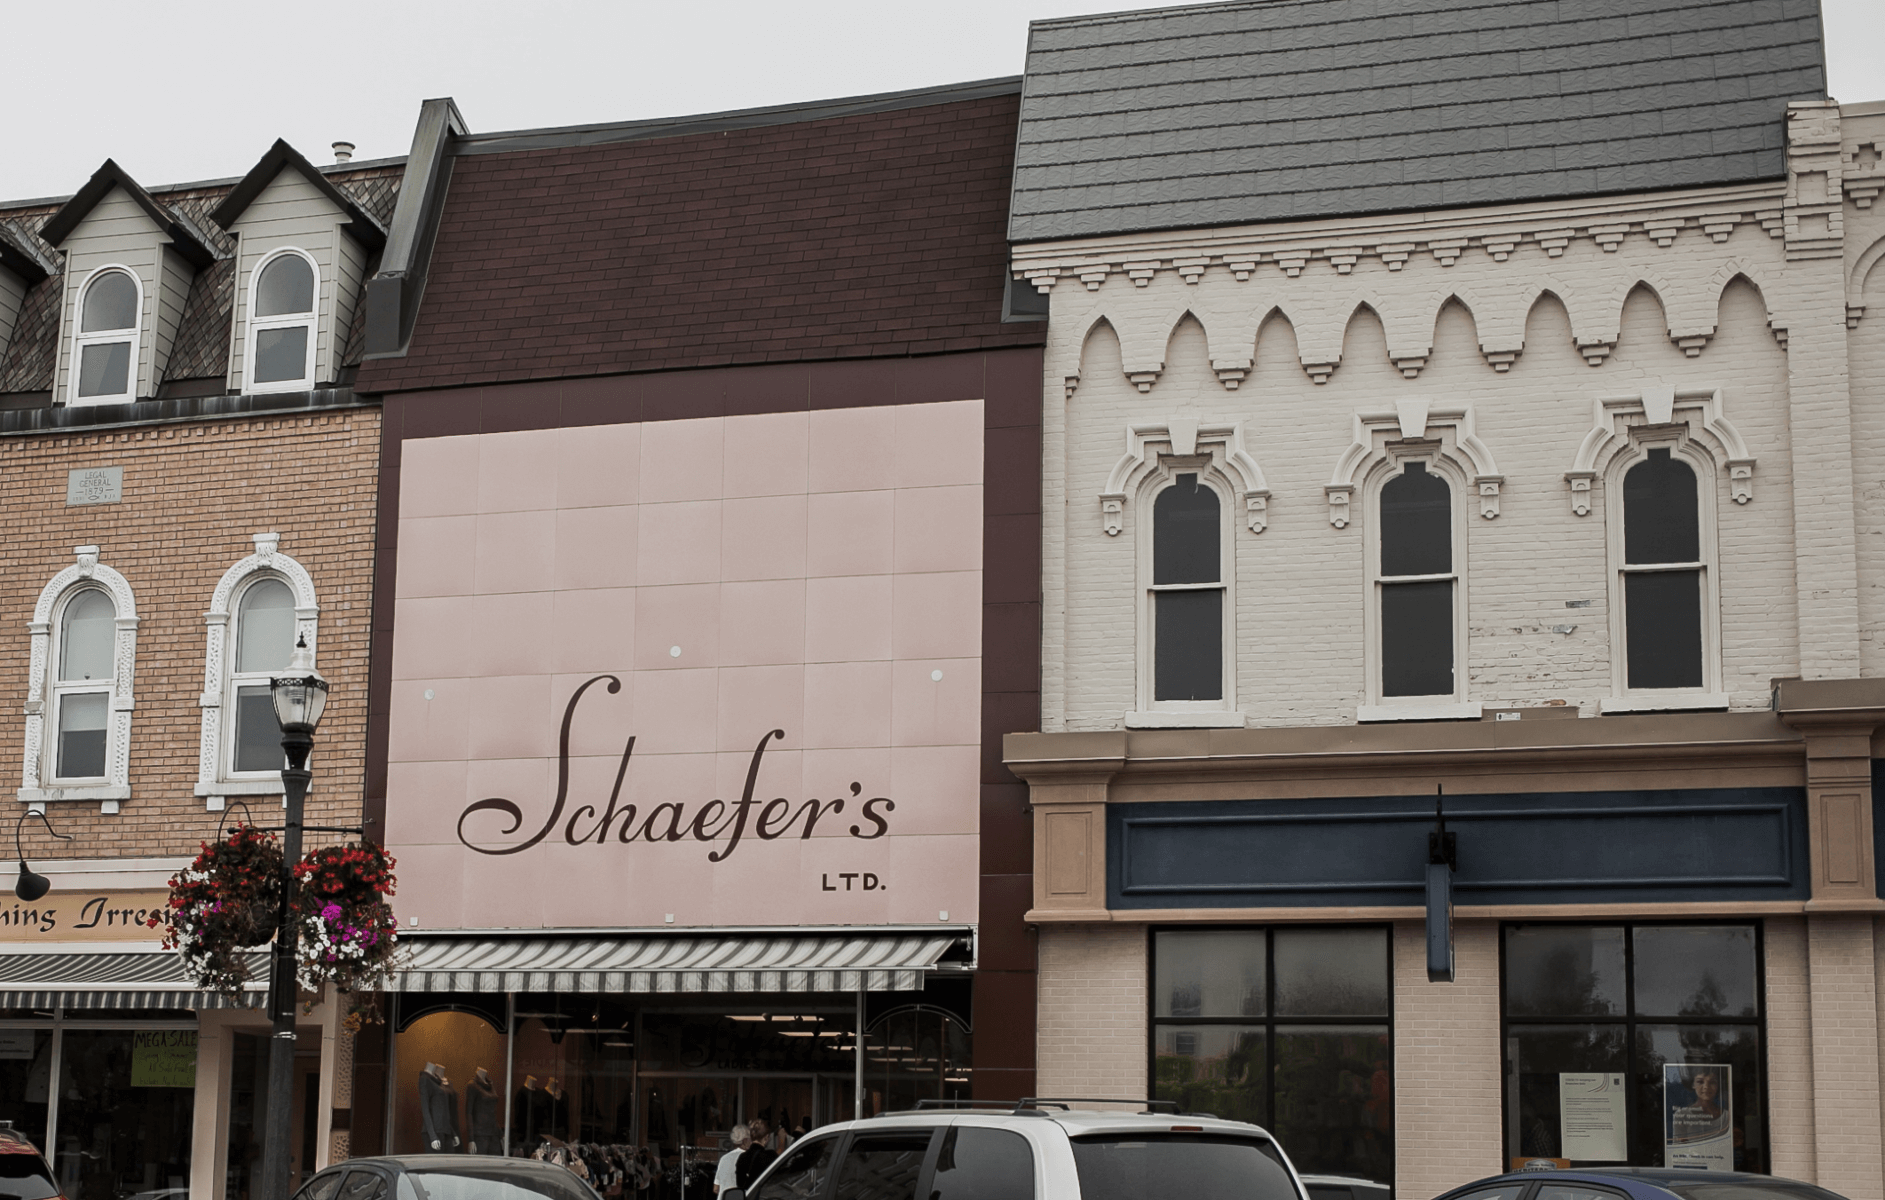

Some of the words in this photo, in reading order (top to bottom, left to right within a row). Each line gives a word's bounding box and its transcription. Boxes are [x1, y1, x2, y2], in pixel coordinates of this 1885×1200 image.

[84, 471, 107, 479] LEGAL
[79, 478, 111, 488] GENERAL
[84, 487, 104, 496] 1879
[457, 675, 895, 862] Schaefer's
[822, 873, 887, 891] LTD.
